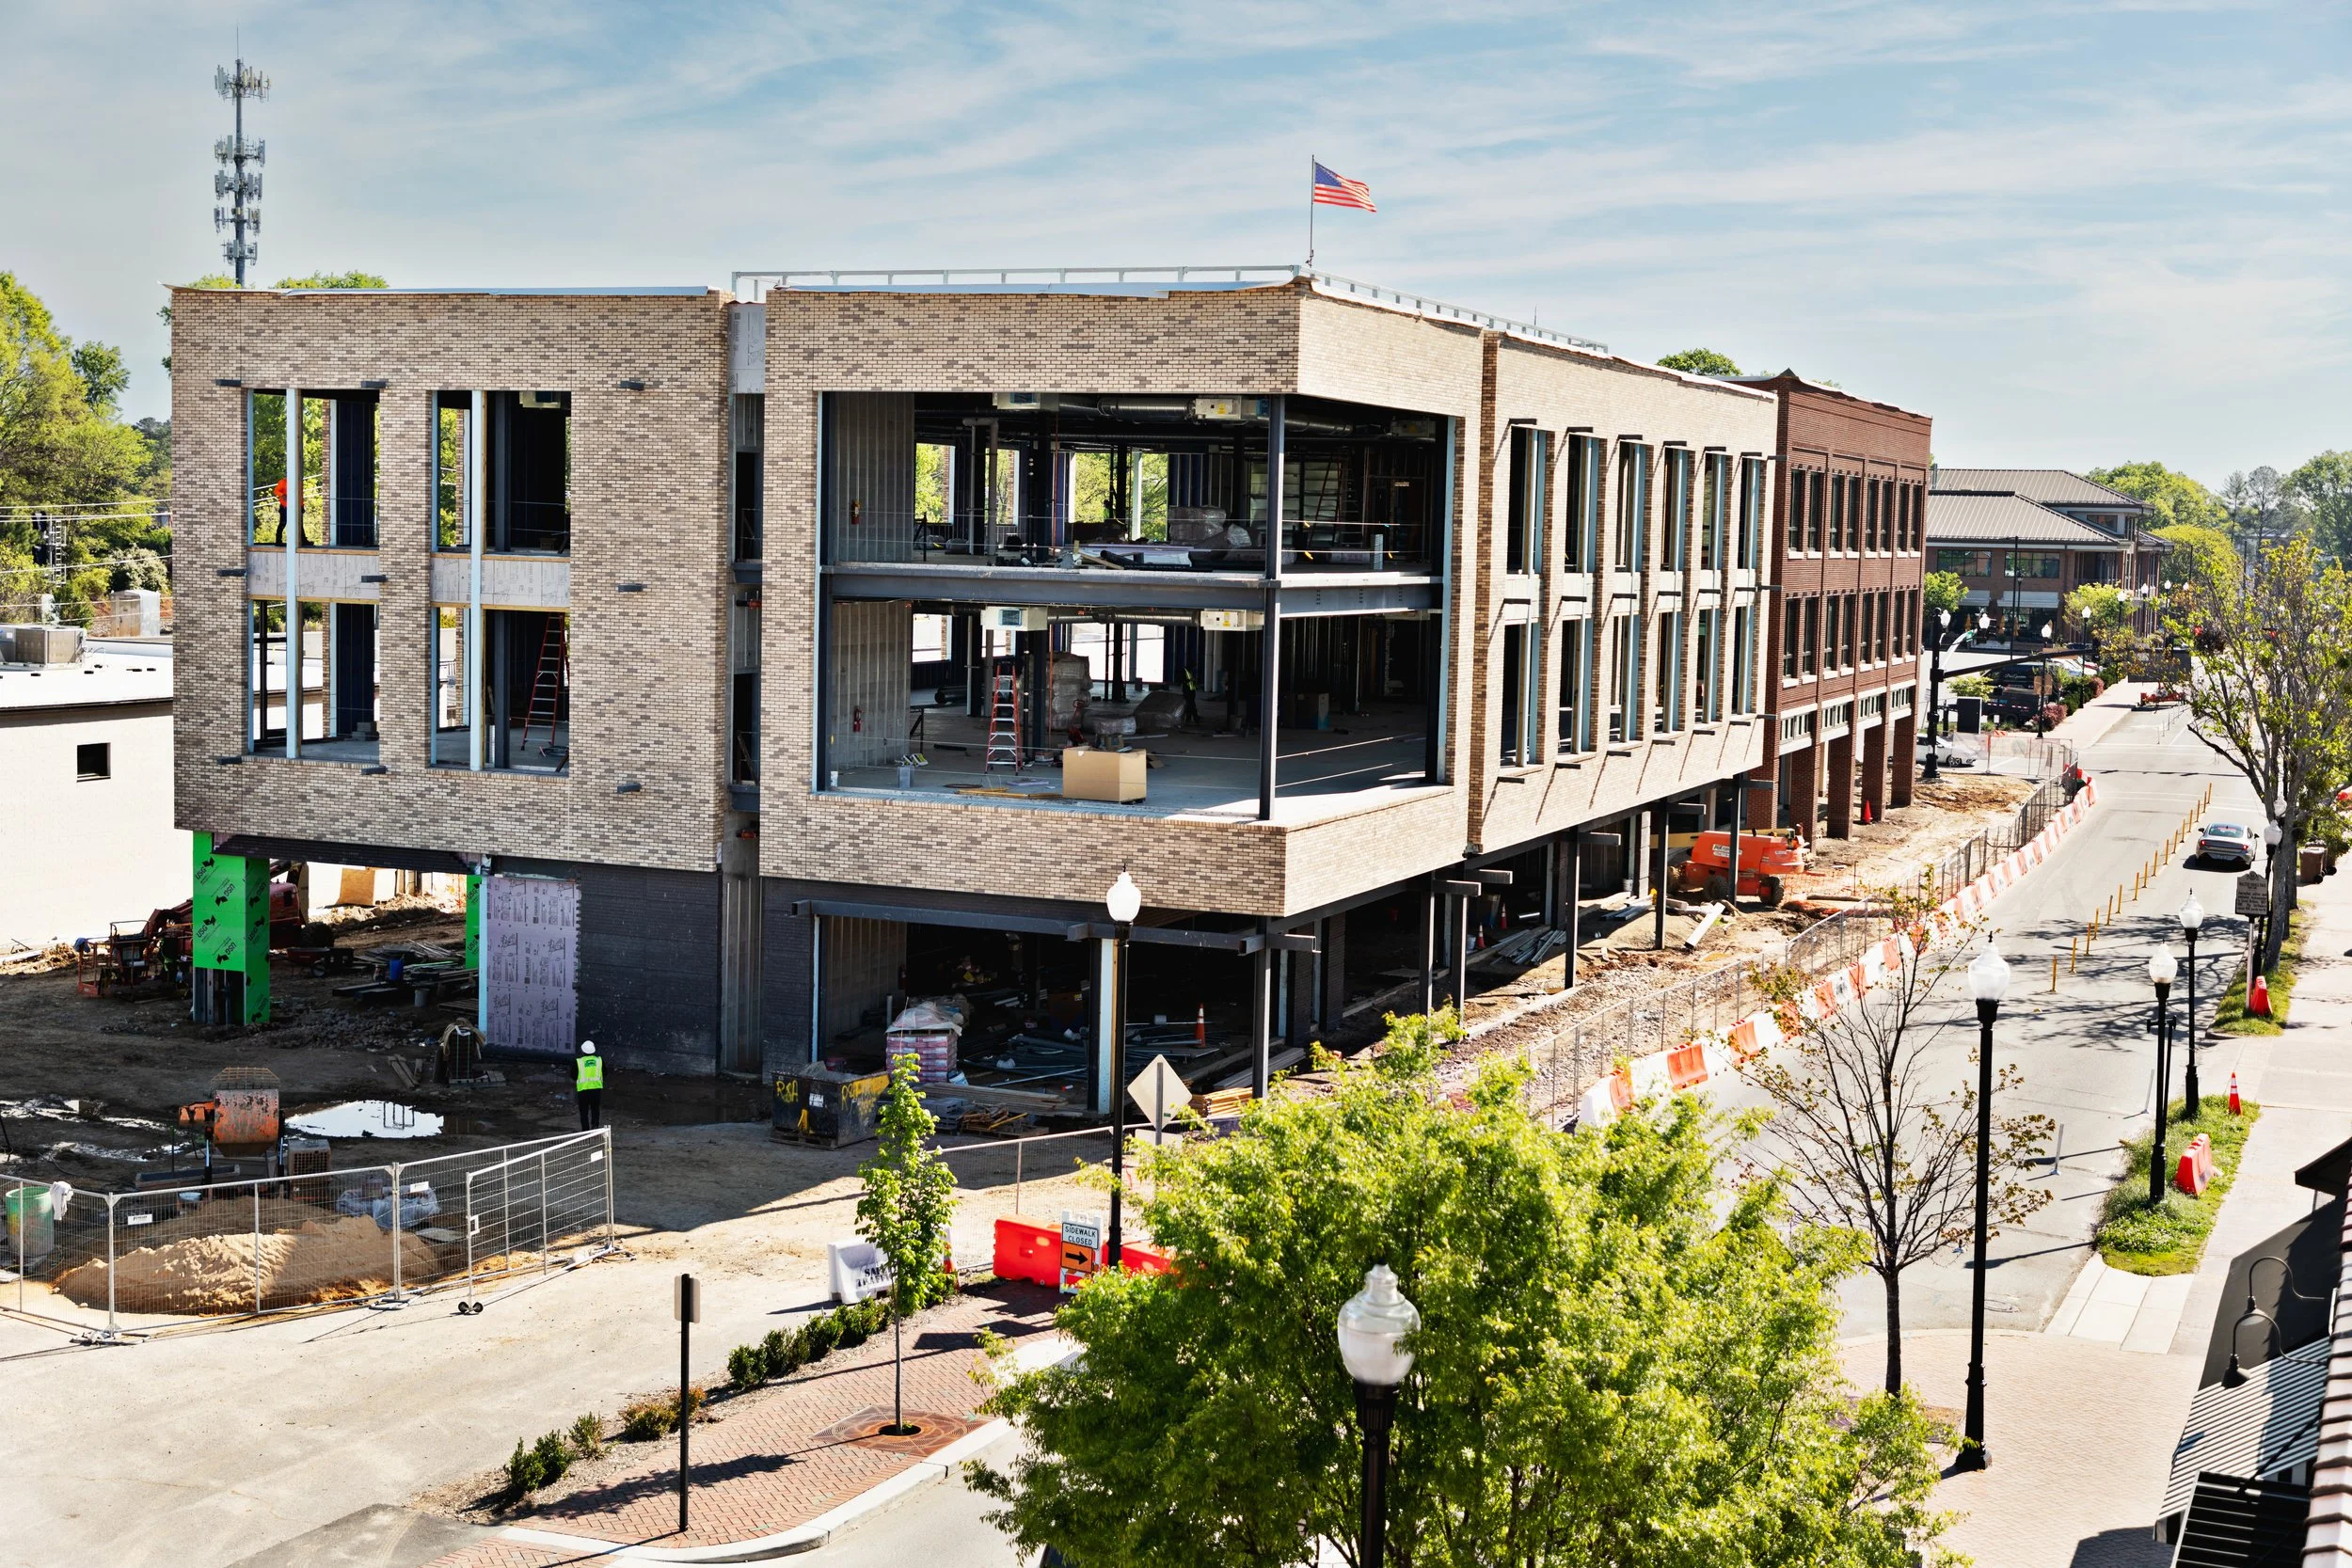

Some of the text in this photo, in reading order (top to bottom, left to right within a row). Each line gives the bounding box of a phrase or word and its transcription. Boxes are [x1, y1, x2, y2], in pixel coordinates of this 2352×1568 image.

[196, 866, 207, 879] USG
[224, 883, 235, 896] USG
[197, 925, 208, 938] USG
[225, 942, 237, 955] USG
[468, 939, 478, 951] USG
[1065, 1226, 1096, 1238] SIDEWALK
[1068, 1235, 1093, 1246] CLOSED
